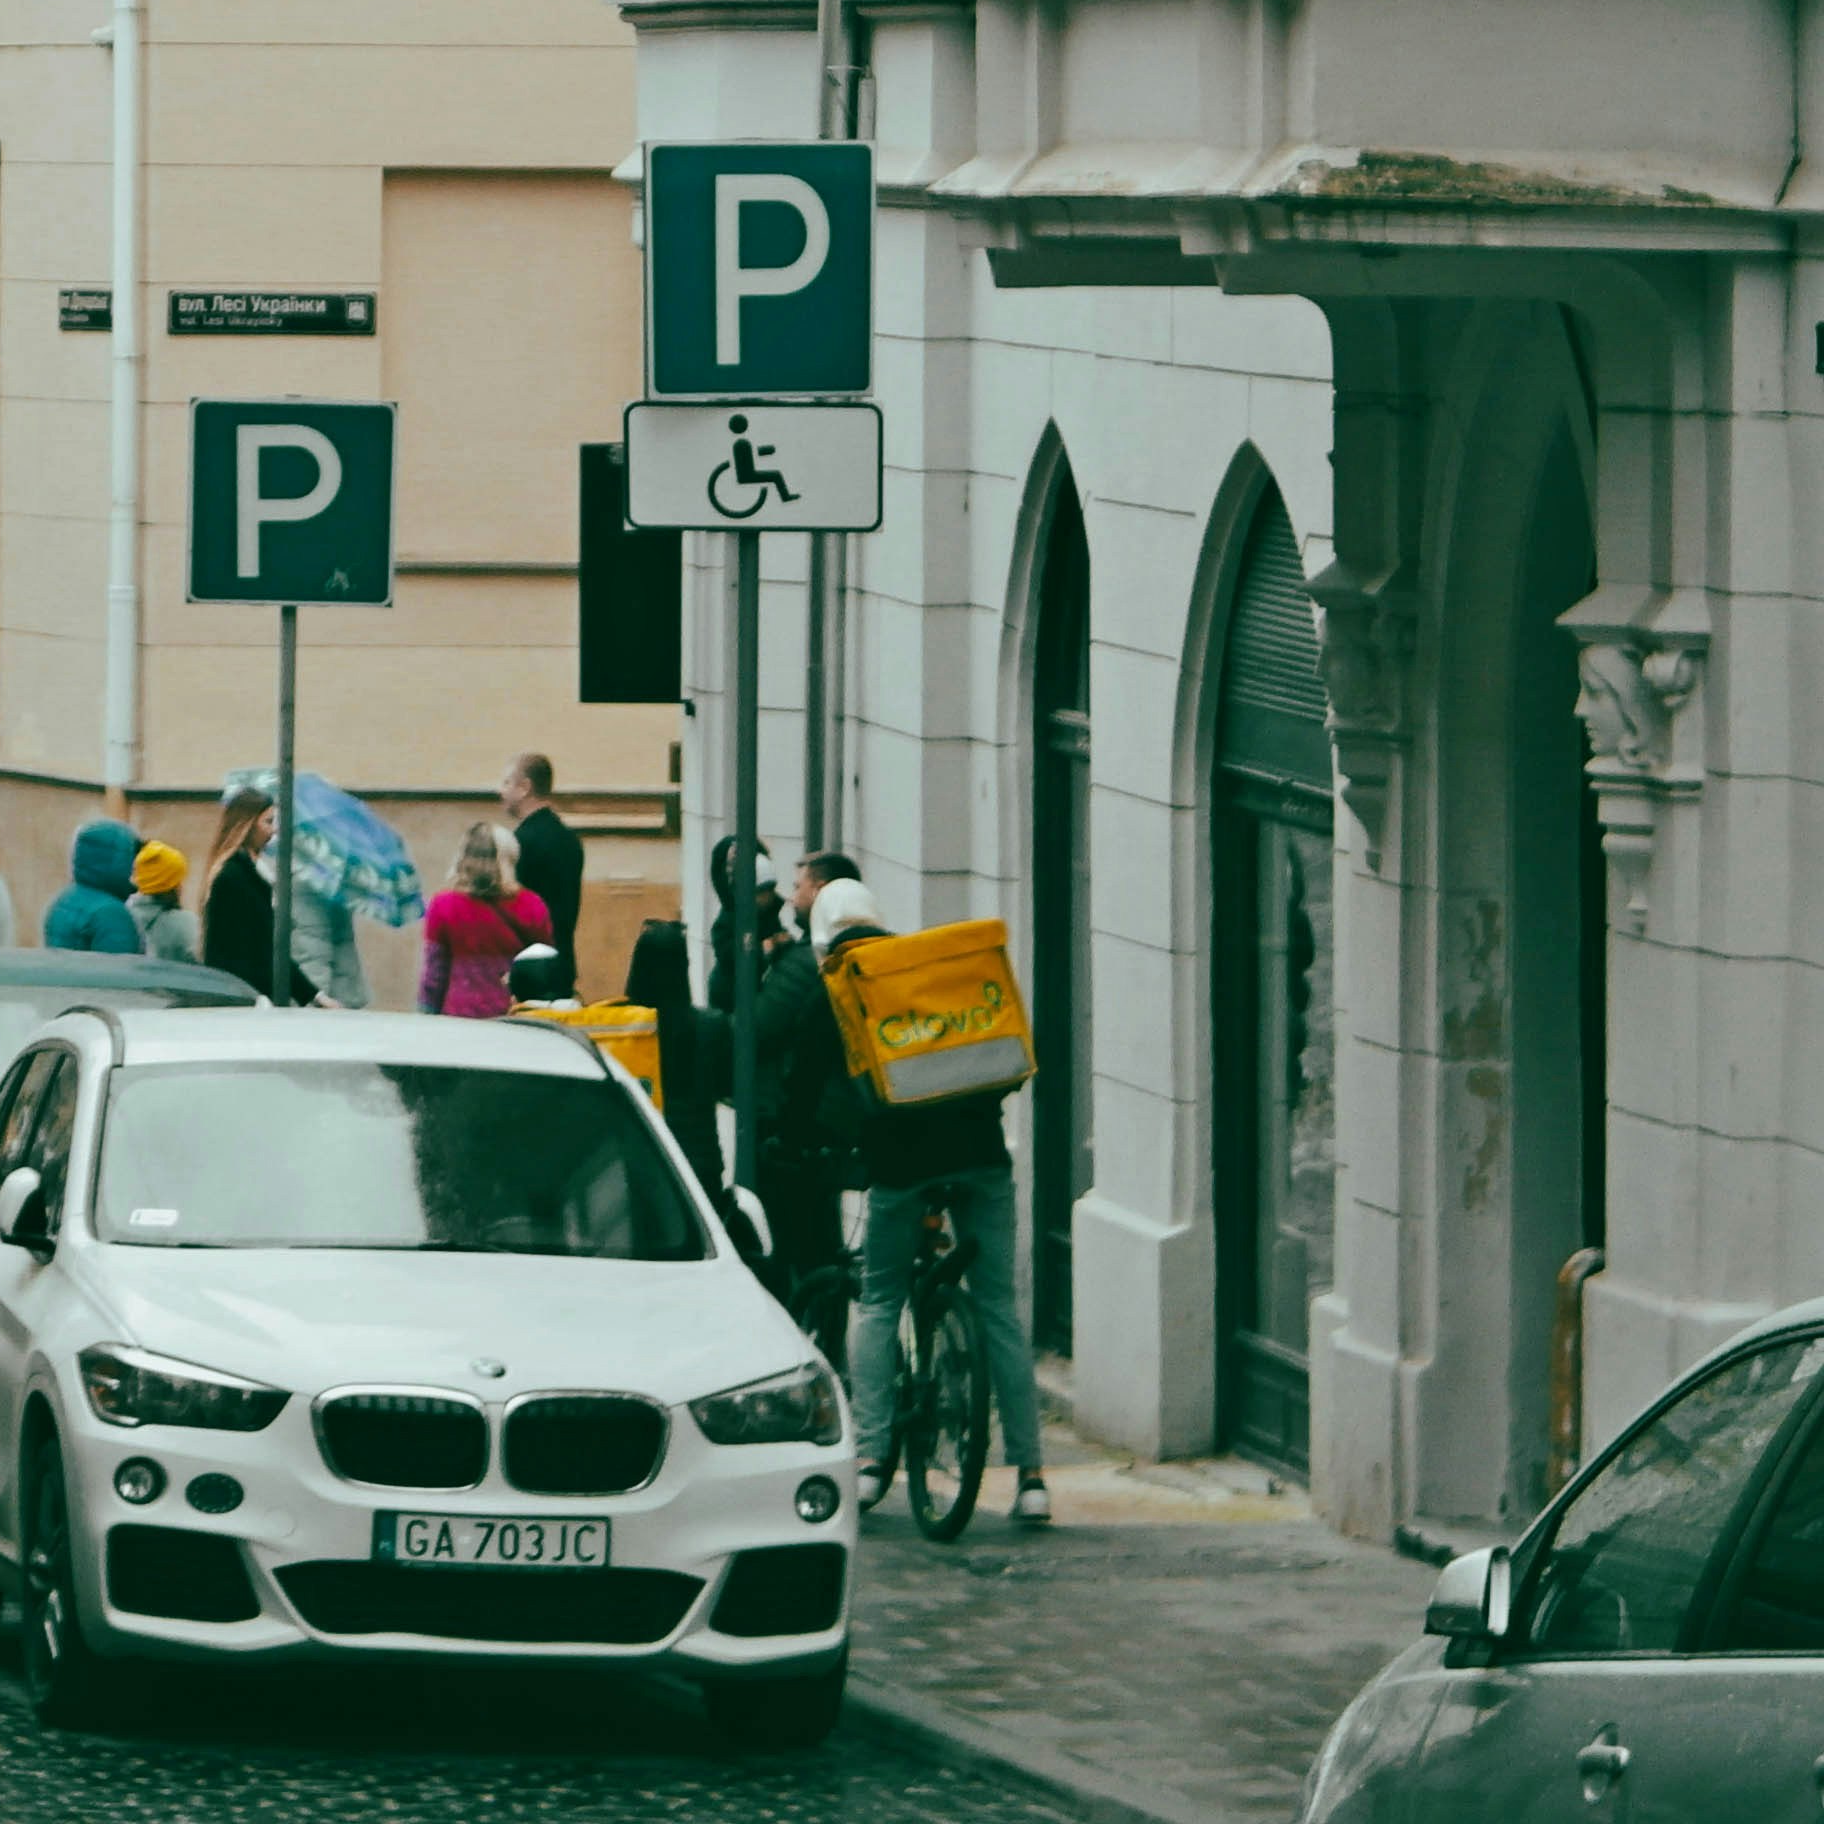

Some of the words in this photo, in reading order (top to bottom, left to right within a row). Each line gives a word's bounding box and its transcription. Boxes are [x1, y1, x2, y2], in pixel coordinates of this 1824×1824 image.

[715, 173, 830, 365] P
[178, 298, 207, 312] вул.
[211, 295, 246, 312] Лесі
[251, 295, 327, 314] Українки
[237, 424, 342, 578] P
[878, 1005, 997, 1049] Glovo
[405, 1519, 455, 1558] GA
